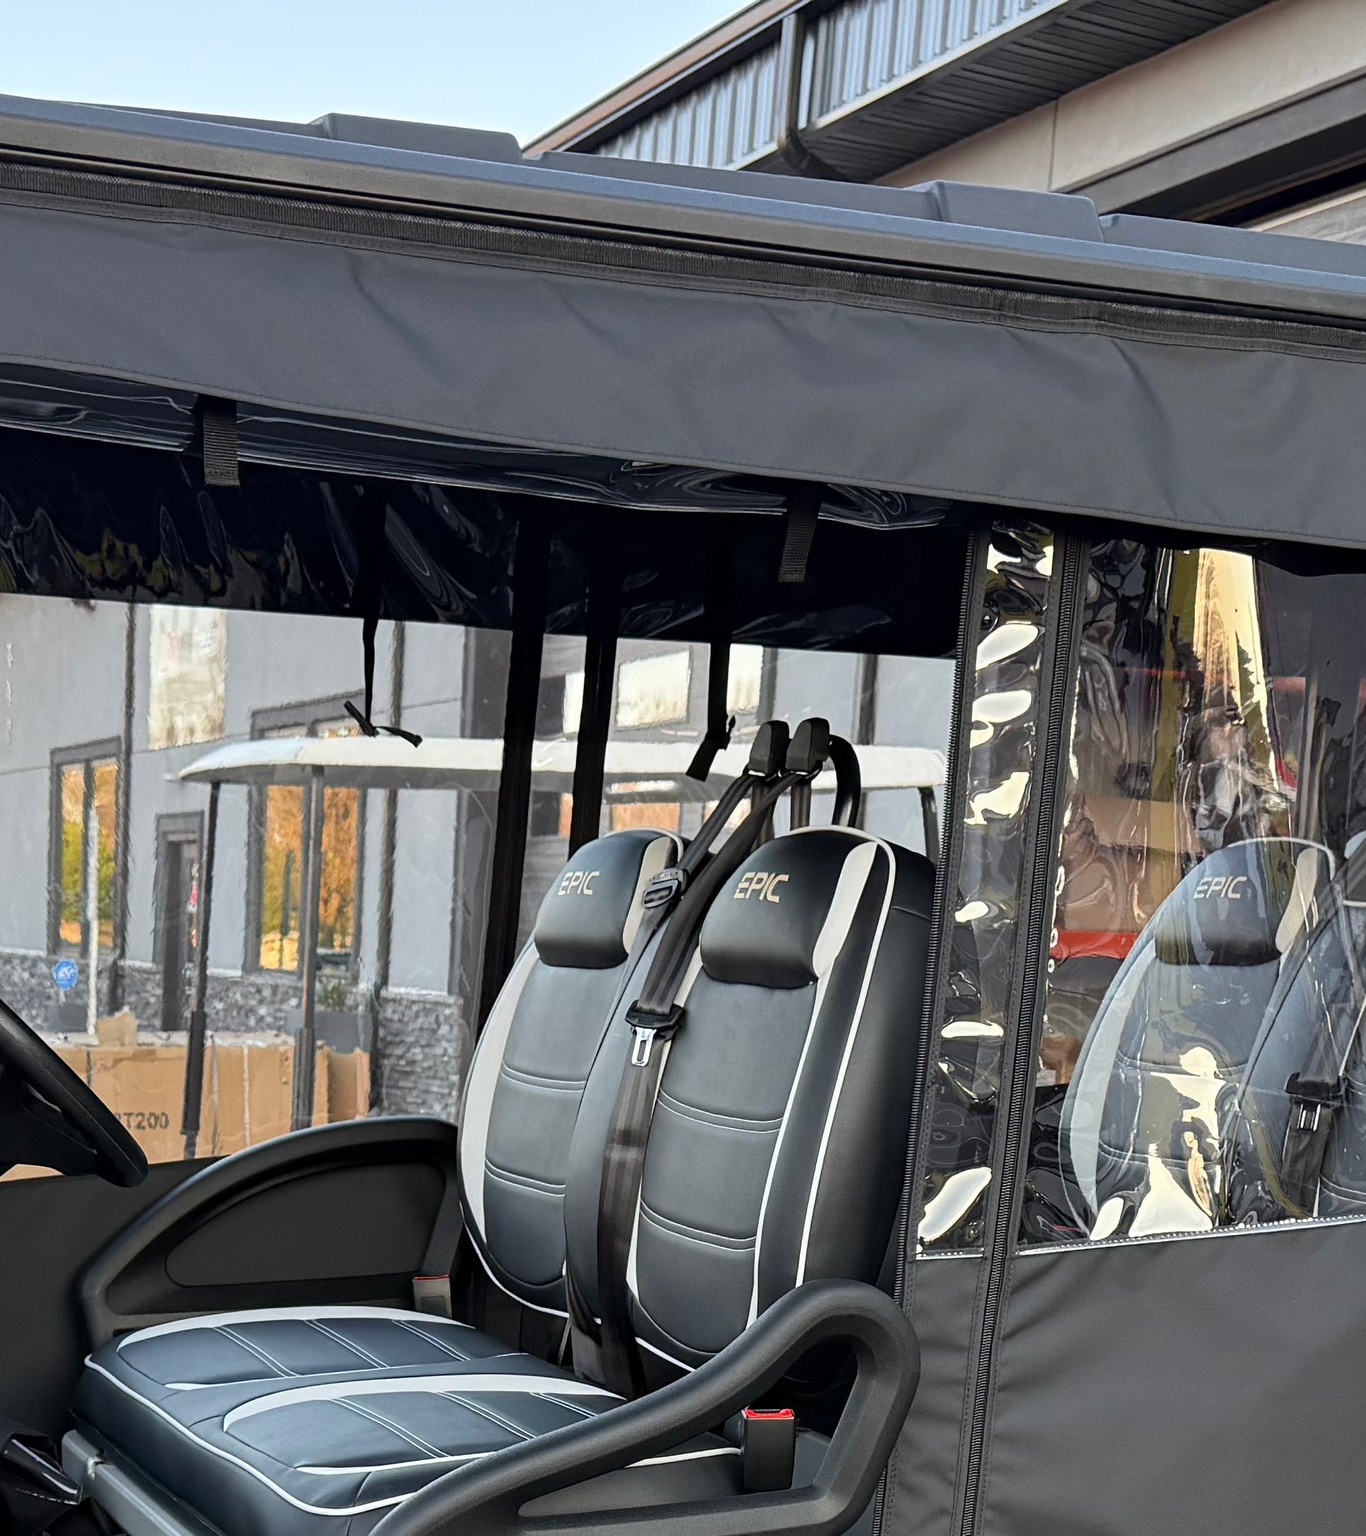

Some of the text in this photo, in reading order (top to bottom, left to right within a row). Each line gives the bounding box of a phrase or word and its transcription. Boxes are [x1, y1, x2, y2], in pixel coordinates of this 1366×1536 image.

[558, 871, 601, 896] EPIC
[733, 872, 789, 903] EPIC
[1193, 876, 1247, 899] EPIC
